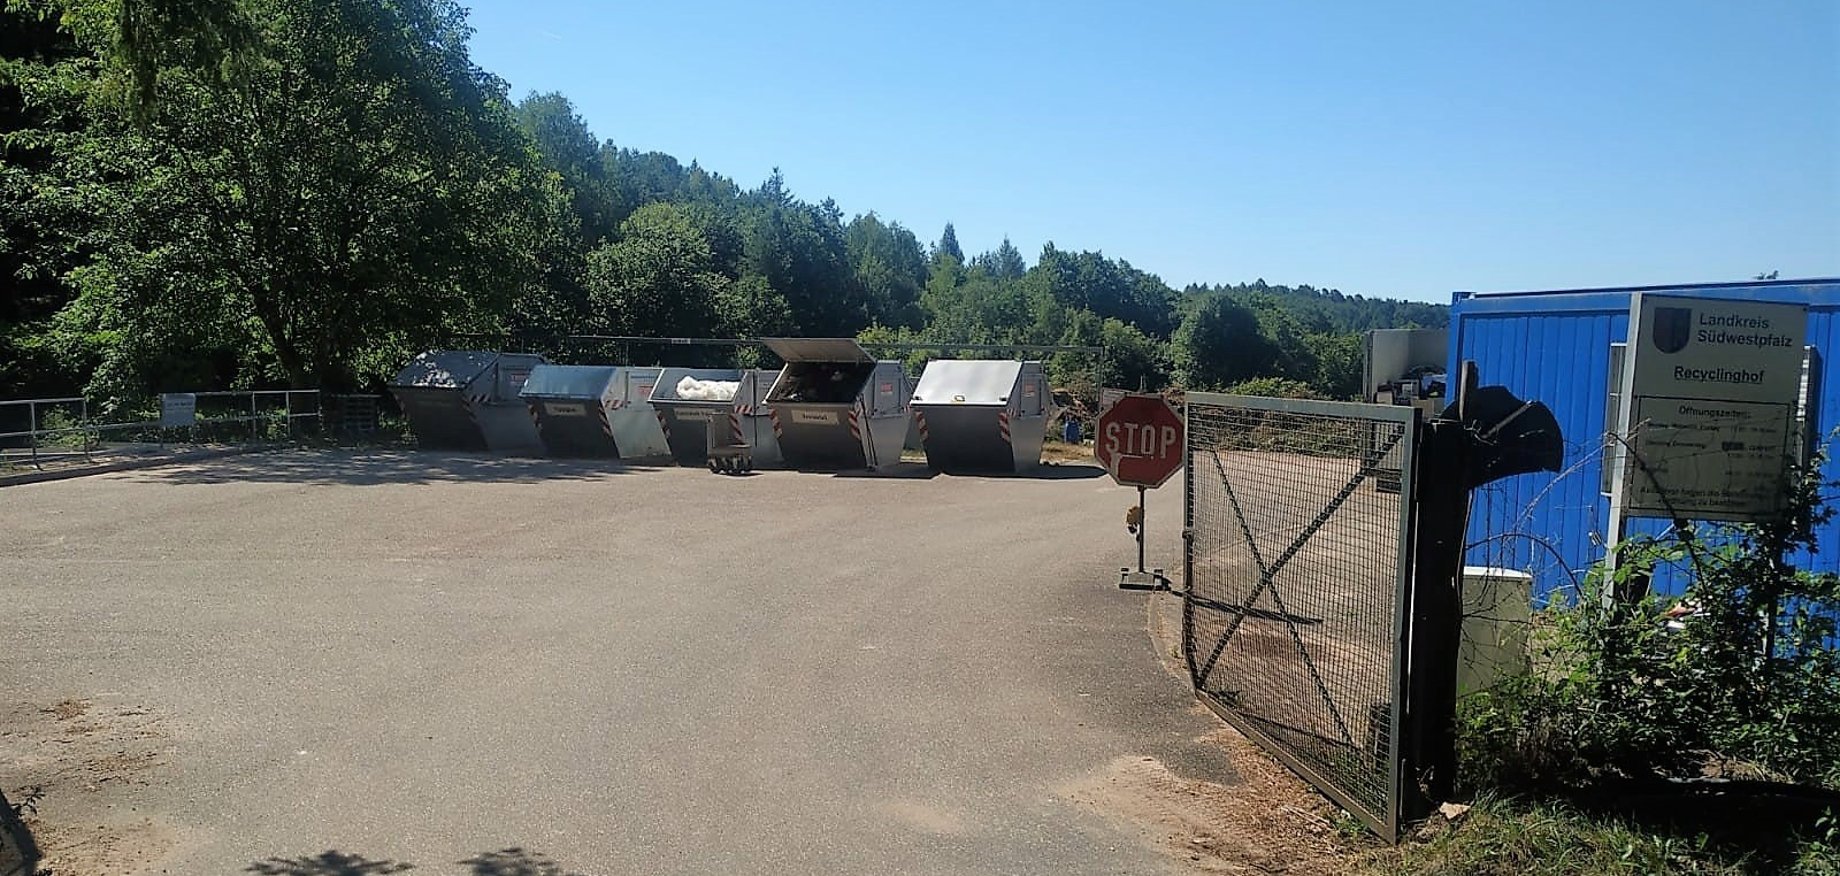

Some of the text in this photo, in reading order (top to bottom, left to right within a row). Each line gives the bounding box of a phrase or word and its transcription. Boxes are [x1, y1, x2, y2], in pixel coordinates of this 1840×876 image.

[1700, 313, 1770, 329] Landkreis
[1697, 329, 1793, 349] Südwestpfalz
[1673, 366, 1765, 384] Recyclinghof
[1105, 421, 1177, 459] STOP
